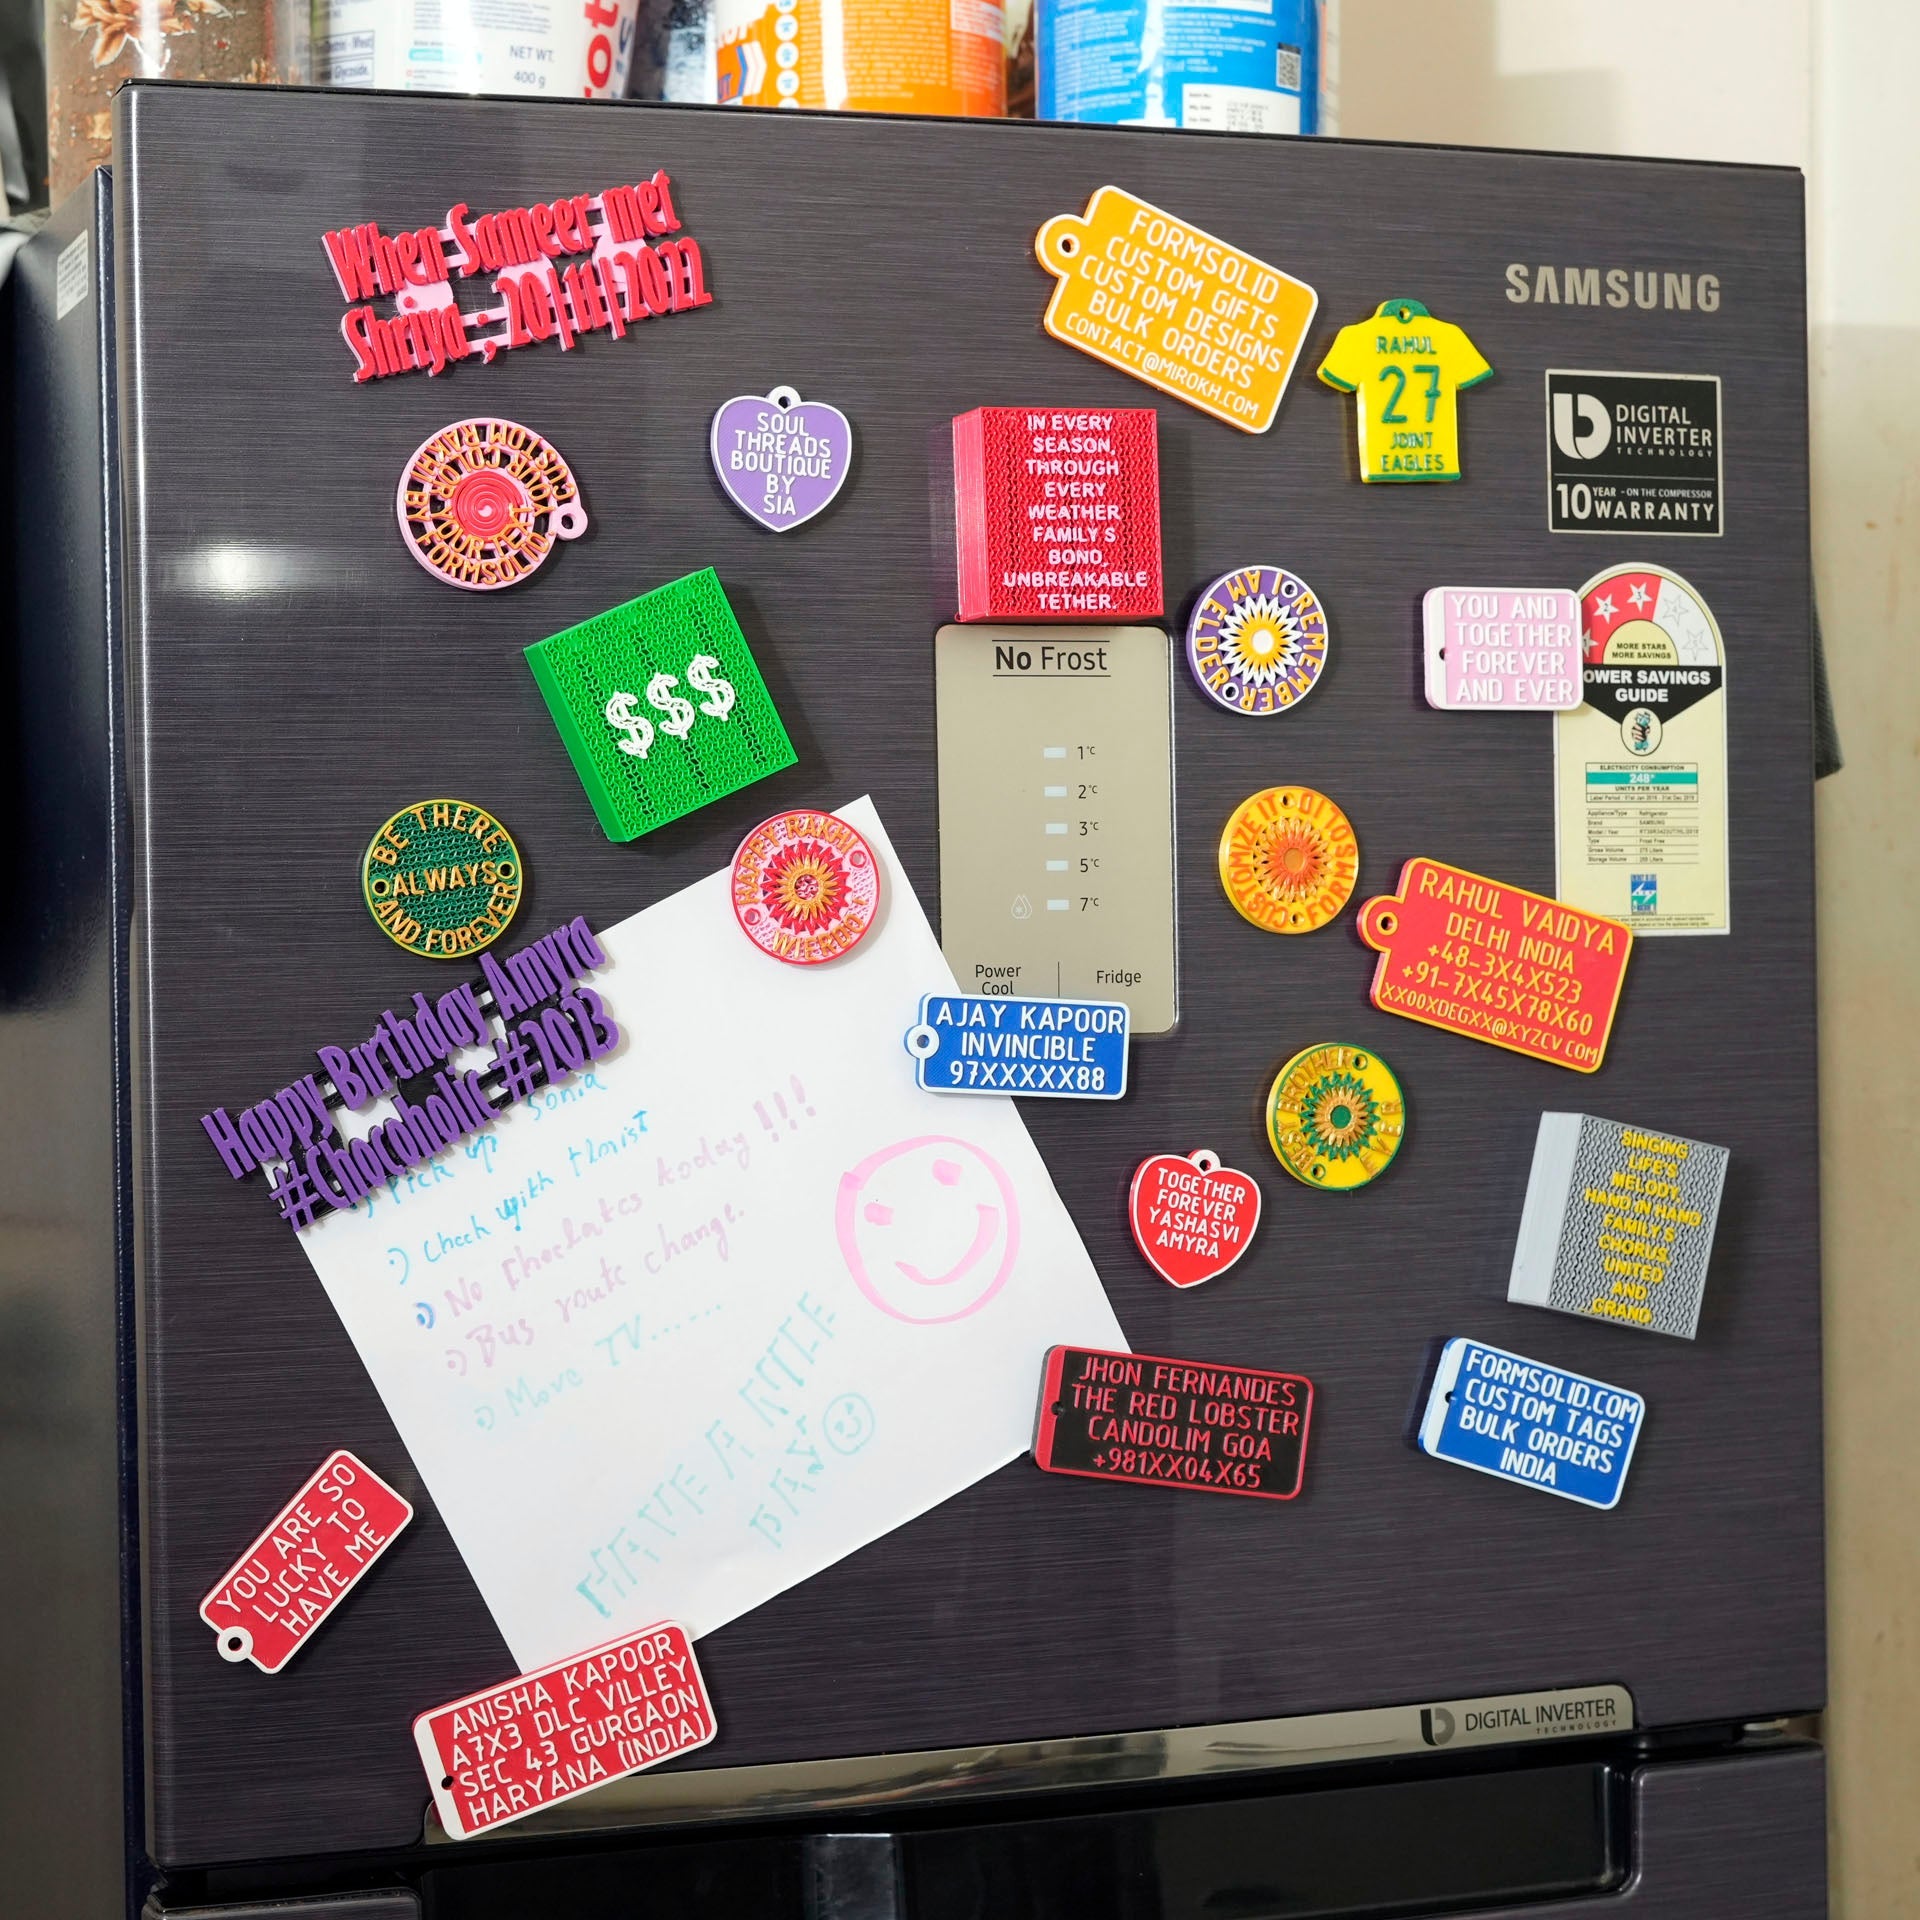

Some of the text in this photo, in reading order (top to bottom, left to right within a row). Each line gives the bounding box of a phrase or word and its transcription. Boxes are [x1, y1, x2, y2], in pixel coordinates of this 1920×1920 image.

[510, 45, 532, 59] NET
[513, 70, 546, 88] 400 g
[322, 168, 681, 303] When Sameer met
[1129, 209, 1279, 304] FORMSOLID
[1106, 236, 1278, 338] CUSTOM GIFTS
[1505, 263, 1721, 313] SAMSUNG
[1080, 255, 1284, 372] CUSTOM DESIGNS
[1088, 290, 1255, 389] BULK ORDERS
[1376, 336, 1437, 354] RAHUL
[1066, 312, 1259, 419] CONTACT@MIROKH.COM
[1379, 365, 1441, 423] 27
[757, 412, 810, 437] SOUL
[1027, 415, 1113, 432] IN EVERY
[1616, 404, 1691, 425] DIGITAL
[735, 429, 832, 459] THREADS
[1390, 432, 1433, 449] JOINT
[1616, 426, 1712, 447] INVERTER
[1616, 447, 1713, 457] TECHNOLOGY
[404, 422, 576, 522] CUSTOM RAKHI BY
[730, 450, 832, 480] BOUTIQUE
[1025, 459, 1120, 476] THROUGH
[1381, 454, 1445, 472] EAGLES
[766, 473, 796, 495] BY
[1045, 482, 1107, 498] EVERY
[429, 445, 556, 560] YOUR COLOR YOUR TEXT
[763, 494, 796, 516] SIA
[1028, 504, 1121, 521] WEATHER
[1556, 483, 1592, 520] 10
[1592, 487, 1616, 497] YEAR
[1641, 488, 1657, 498] THE
[1658, 489, 1712, 499] COMPRESSOR
[1594, 500, 1714, 522] WARRANTY
[1003, 571, 1148, 588] UNBREAKABLE
[1451, 594, 1576, 620] YOU AND I
[1195, 569, 1283, 692] I AM ELDER
[1455, 622, 1573, 648] TOGETHER
[1616, 642, 1667, 651] MORE STARS
[996, 646, 1108, 671] No Frost
[1239, 591, 1327, 711] REMEMBER
[1462, 651, 1566, 676] FOREVER
[1611, 651, 1672, 660] MORE SAVINGS
[1455, 678, 1574, 703] AND EVER
[1582, 669, 1712, 686] OWER SAVINGS
[1615, 688, 1669, 703] GUIDE
[373, 803, 507, 866] BE THERE
[737, 815, 858, 905] HAPPY RAKHI
[393, 861, 498, 896] ALWAYS
[375, 882, 518, 954] AND FOREVER
[1419, 868, 1614, 955] RAHUL VAIDYA
[1446, 912, 1574, 974] DELHI INDIA
[975, 964, 1022, 979] Power
[981, 981, 1015, 996] Cool
[1096, 970, 1142, 987] Fridge
[1428, 940, 1582, 1004] +48-3X4X523
[1402, 961, 1593, 1036] +91-7X45X78X60
[935, 1001, 1124, 1034] AJAY KAPOOR
[200, 915, 606, 1181] Happy Birthday Amyra
[961, 1032, 1097, 1063] INVINCIBLE
[950, 1060, 1106, 1091] 97XXXXX88
[269, 986, 620, 1232] #Chocoholic #2023
[1622, 1129, 1688, 1160] SINGING
[1158, 1167, 1245, 1204] TOGETHER
[1157, 1189, 1236, 1222] FOREVER
[1584, 1187, 1702, 1227] HAND IN HAND
[1150, 1207, 1240, 1243] YASHASVI
[1156, 1230, 1220, 1259] AMYRA
[1604, 1257, 1663, 1283] UNITED
[1612, 1281, 1648, 1300] AND
[1592, 1298, 1652, 1323] GRAND
[1079, 1356, 1296, 1407] JHON FERNANDES
[1466, 1349, 1640, 1425] FORMSOLID.COM
[1072, 1383, 1299, 1436] THE RED LOBSTER
[1464, 1378, 1625, 1449] CUSTOM TAGS
[1088, 1416, 1272, 1462] CANDOLIM GOA
[1459, 1405, 1615, 1474] BULK ORDERS
[1093, 1448, 1262, 1489] +981XX04X65
[1500, 1447, 1557, 1487] INDIA
[216, 1463, 356, 1613] YOU ARE SO
[252, 1498, 365, 1623] LUCKY TO
[280, 1521, 386, 1637] HAVE ME
[452, 1632, 676, 1740] ANISHA KAPOOR
[453, 1655, 687, 1771] A7X3 DLC VILLEY
[1465, 1698, 1616, 1732] DIGITAL INVERTER
[1536, 1719, 1617, 1735] TECHNOLOGY
[460, 1684, 700, 1798] SEC 43 GURGAON
[467, 1711, 707, 1827] HARYANA (INDIA)
